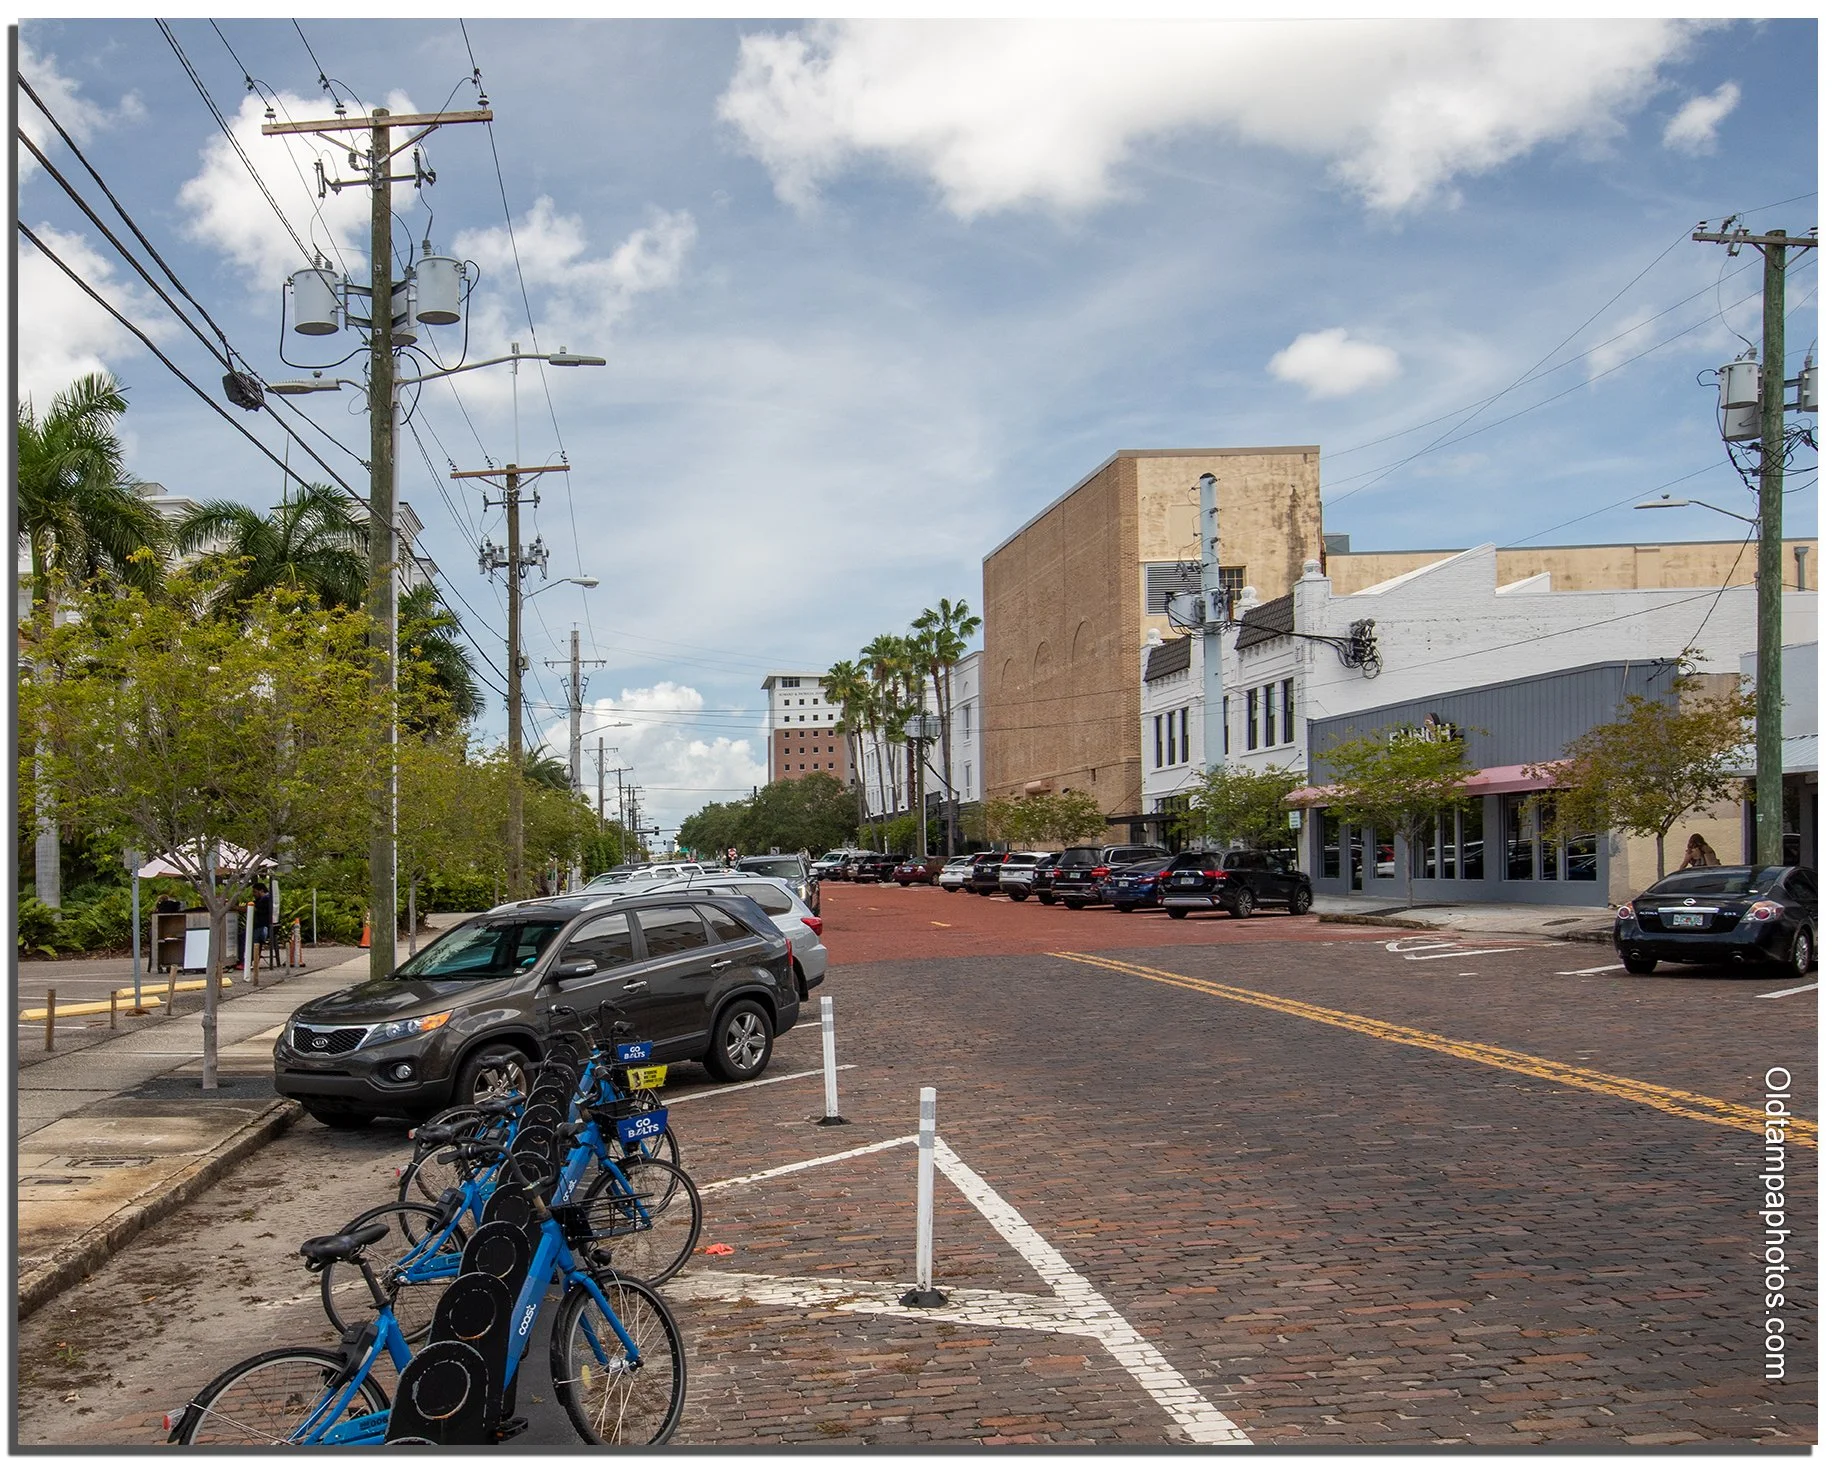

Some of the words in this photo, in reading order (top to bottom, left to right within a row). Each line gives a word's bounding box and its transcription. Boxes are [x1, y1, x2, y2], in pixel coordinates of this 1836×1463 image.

[624, 1051, 646, 1059] BOLTS
[636, 1118, 651, 1127] GO
[628, 1123, 660, 1138] BOLTS
[518, 1303, 537, 1336] coast
